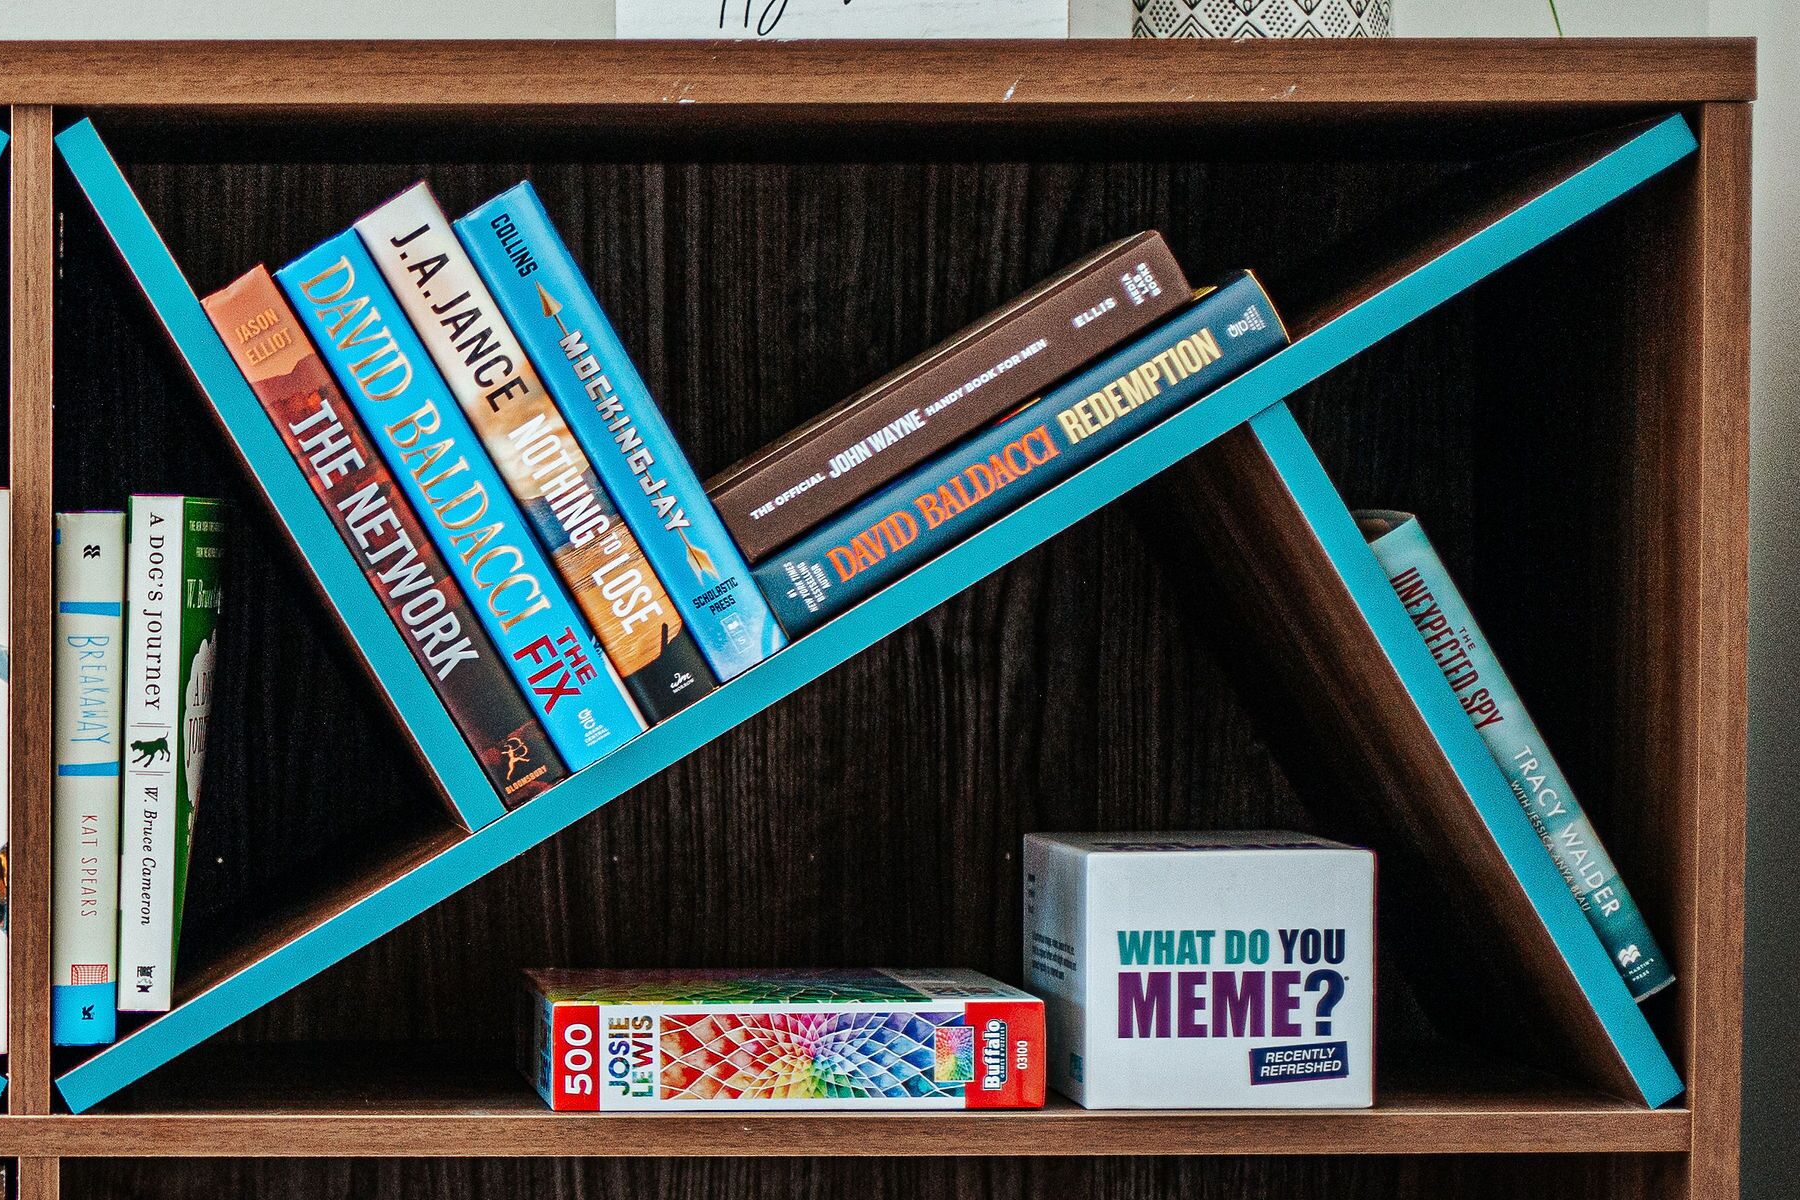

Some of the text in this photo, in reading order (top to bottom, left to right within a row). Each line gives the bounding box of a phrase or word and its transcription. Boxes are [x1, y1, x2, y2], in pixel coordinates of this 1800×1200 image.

[490, 213, 538, 278] COLLINS
[1136, 262, 1162, 297] BOOKS
[1072, 297, 1116, 328] ELLIS
[1121, 272, 1144, 305] MEDIA
[234, 307, 279, 345] JASON
[245, 327, 293, 367] ELLIOT
[432, 291, 530, 413] JANCE
[1056, 327, 1224, 446] REDEMPTION
[299, 255, 551, 634] DAVID BALDACCI
[559, 329, 691, 532] MOCKINGJAY
[750, 338, 1048, 520] THE OFFICIAL JOHN WAYNE HANDY BOOK FOR MEN
[149, 512, 165, 527] A
[507, 412, 663, 636] NOTHING TO LOSE
[825, 425, 1061, 583] DAVID BALDACCI
[147, 535, 165, 602] DOG'S
[288, 399, 480, 682] THE NETWORK
[692, 576, 739, 609] SCHOLASTIC
[709, 594, 737, 616] PRESS
[554, 626, 598, 686] THE
[1389, 566, 1504, 730] UNEXPECTED SPY
[1458, 626, 1476, 651] THE
[67, 635, 111, 745] BREAKAWAY
[513, 635, 582, 715] FIX
[504, 764, 548, 797] BLOOMSBURY
[80, 814, 98, 917] KAT SPEARS
[140, 786, 159, 927] W. Bruce Cameron
[1510, 780, 1573, 882] WITH JESSICA ANYA
[1514, 745, 1620, 918] TRACY WALDER
[1116, 930, 1216, 966] WHAT
[1224, 928, 1270, 965] DO
[1278, 928, 1346, 965] YOU
[1117, 967, 1346, 1039] MEME?
[564, 1023, 593, 1095] 500
[608, 1017, 630, 1096] JOSIE
[631, 1015, 654, 1098] LEWIS
[983, 1019, 1001, 1090] Buffalo
[1016, 1040, 1028, 1070] 03100
[1260, 1059, 1342, 1078] REFRESHED
[1264, 1047, 1336, 1064] RECENTLY
